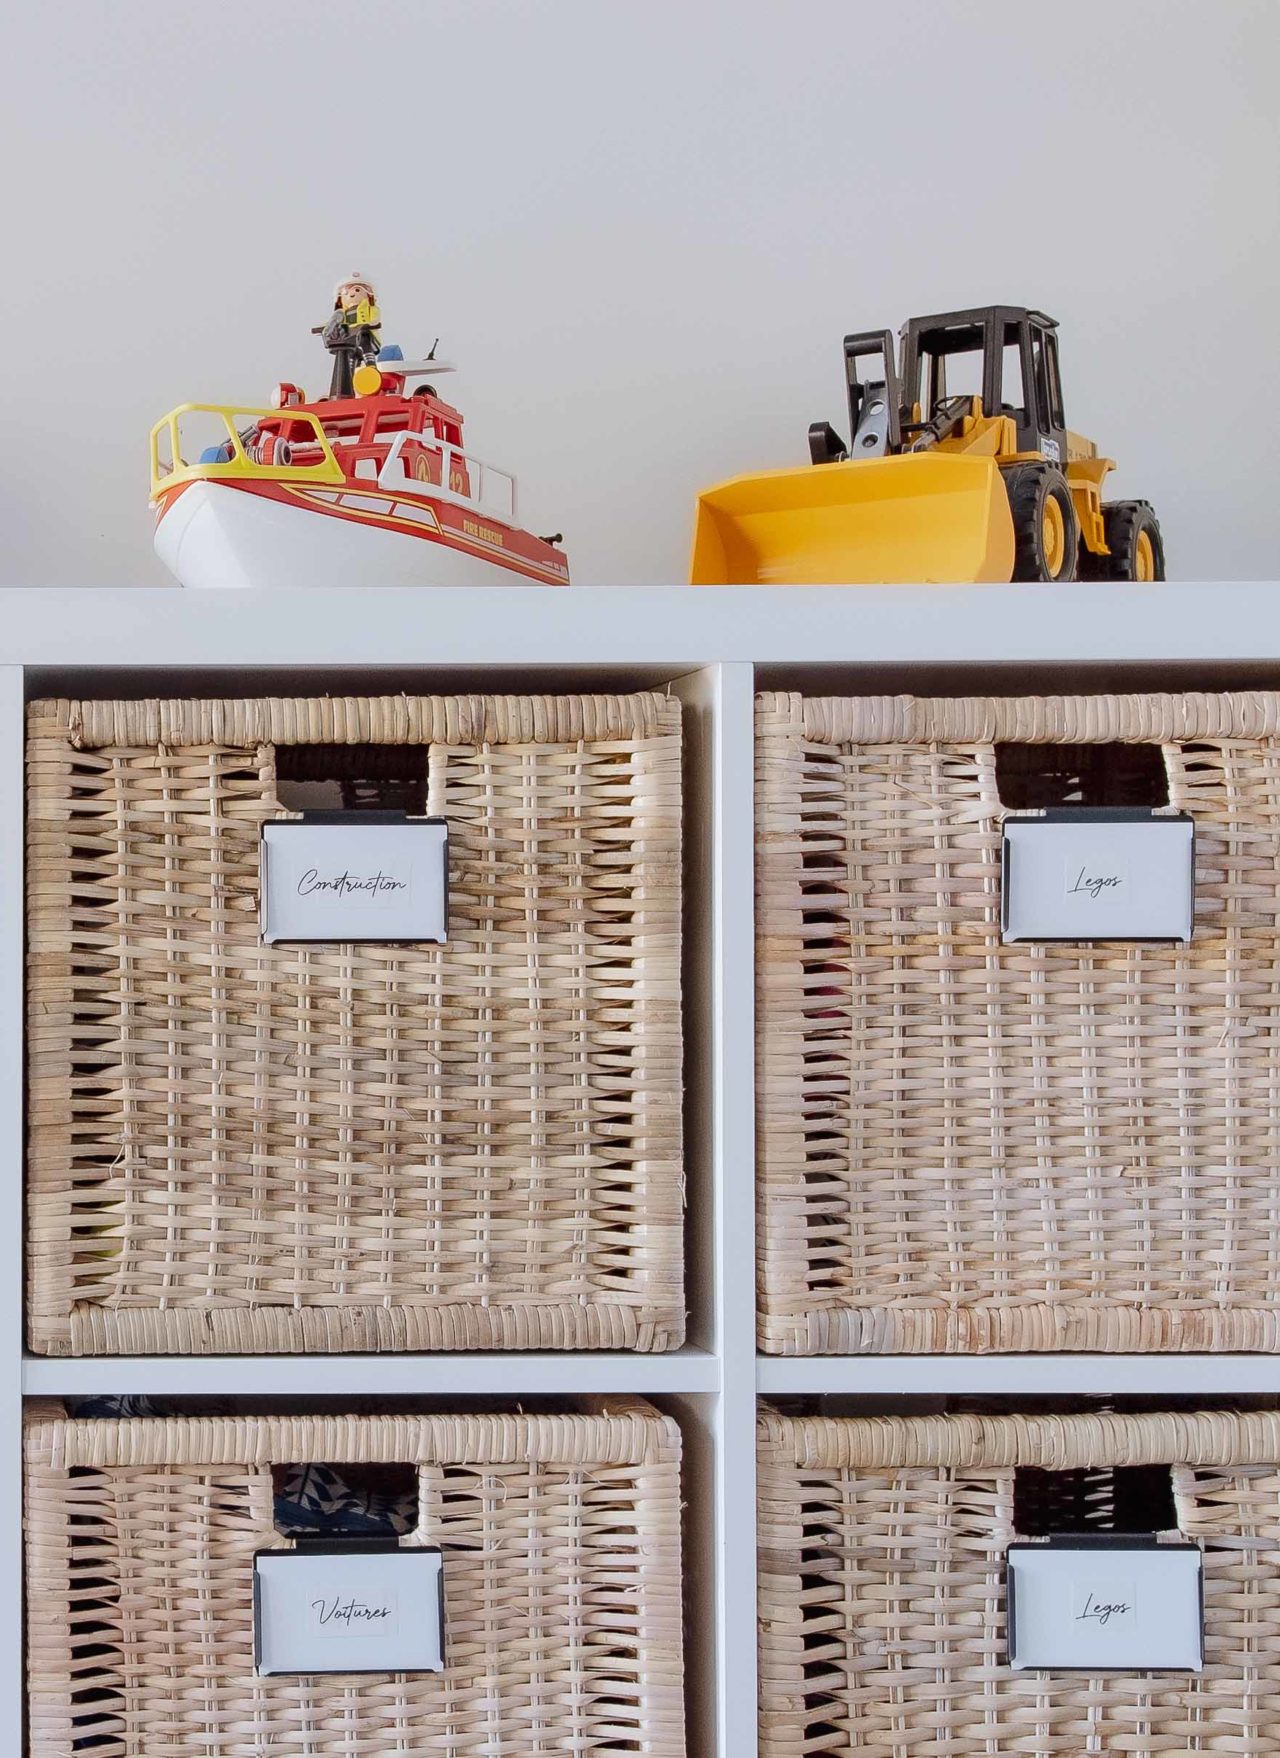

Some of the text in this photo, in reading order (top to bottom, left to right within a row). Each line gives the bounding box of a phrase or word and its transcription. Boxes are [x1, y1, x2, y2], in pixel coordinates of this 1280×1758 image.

[463, 519, 503, 547] FIRE RESCUE
[297, 868, 407, 898] Construction
[1066, 866, 1123, 898] Legos
[311, 1596, 392, 1626] Voitures
[1075, 1593, 1132, 1625] Legos
